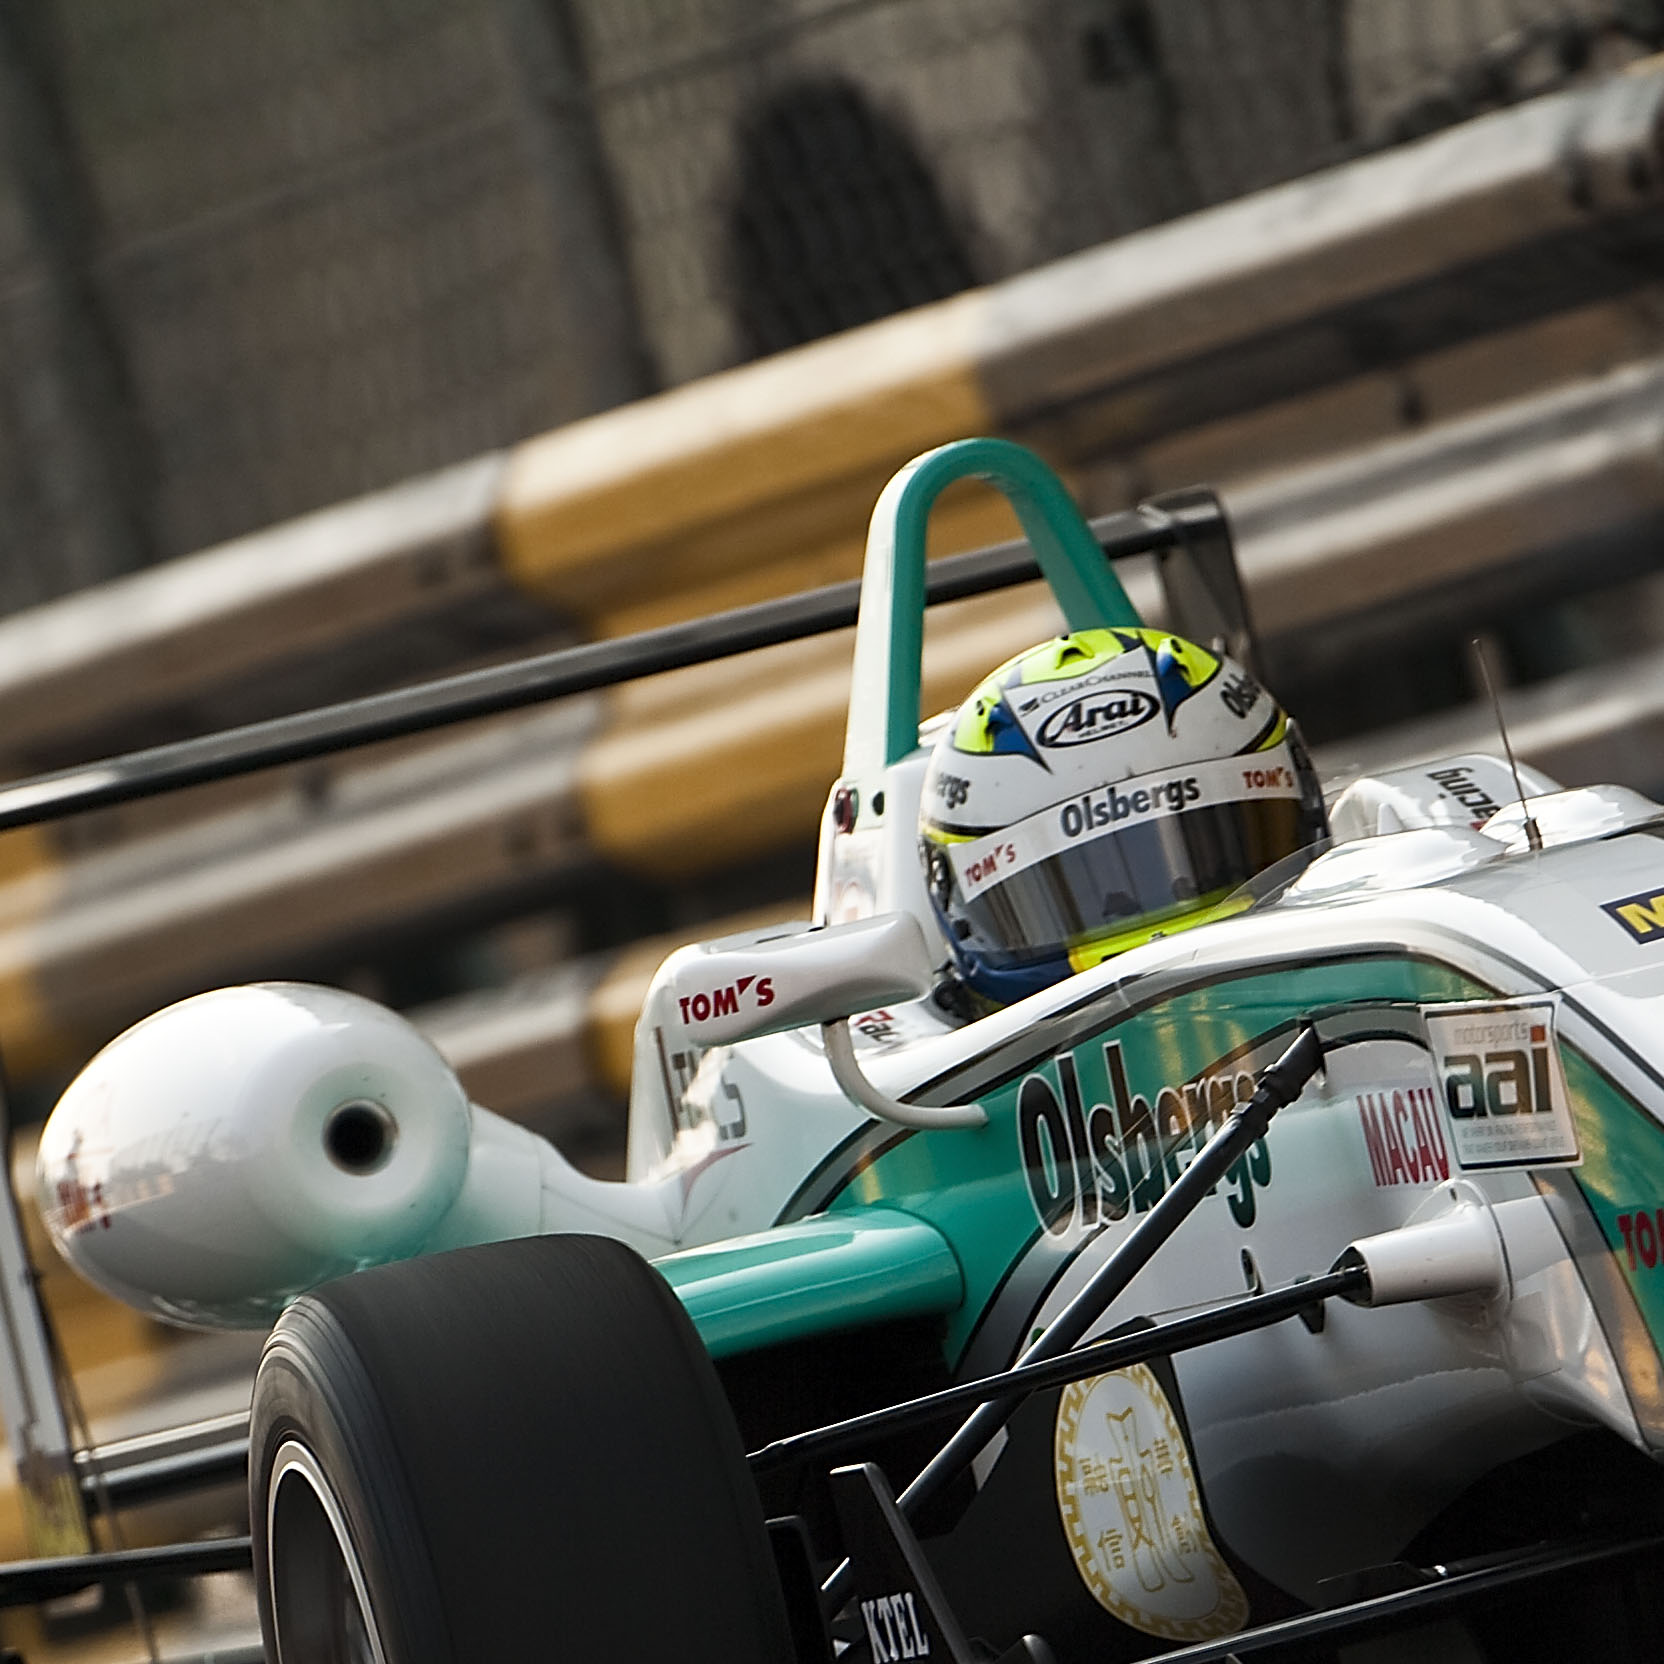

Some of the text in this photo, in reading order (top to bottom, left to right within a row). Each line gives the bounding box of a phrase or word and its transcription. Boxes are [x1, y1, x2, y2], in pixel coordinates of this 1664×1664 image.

[1047, 692, 1147, 743] Arai
[1061, 777, 1200, 837] Olsbergs
[965, 844, 1016, 887] TOM'S
[679, 974, 775, 1025] TOM'S
[1356, 1088, 1450, 1186] MACAU
